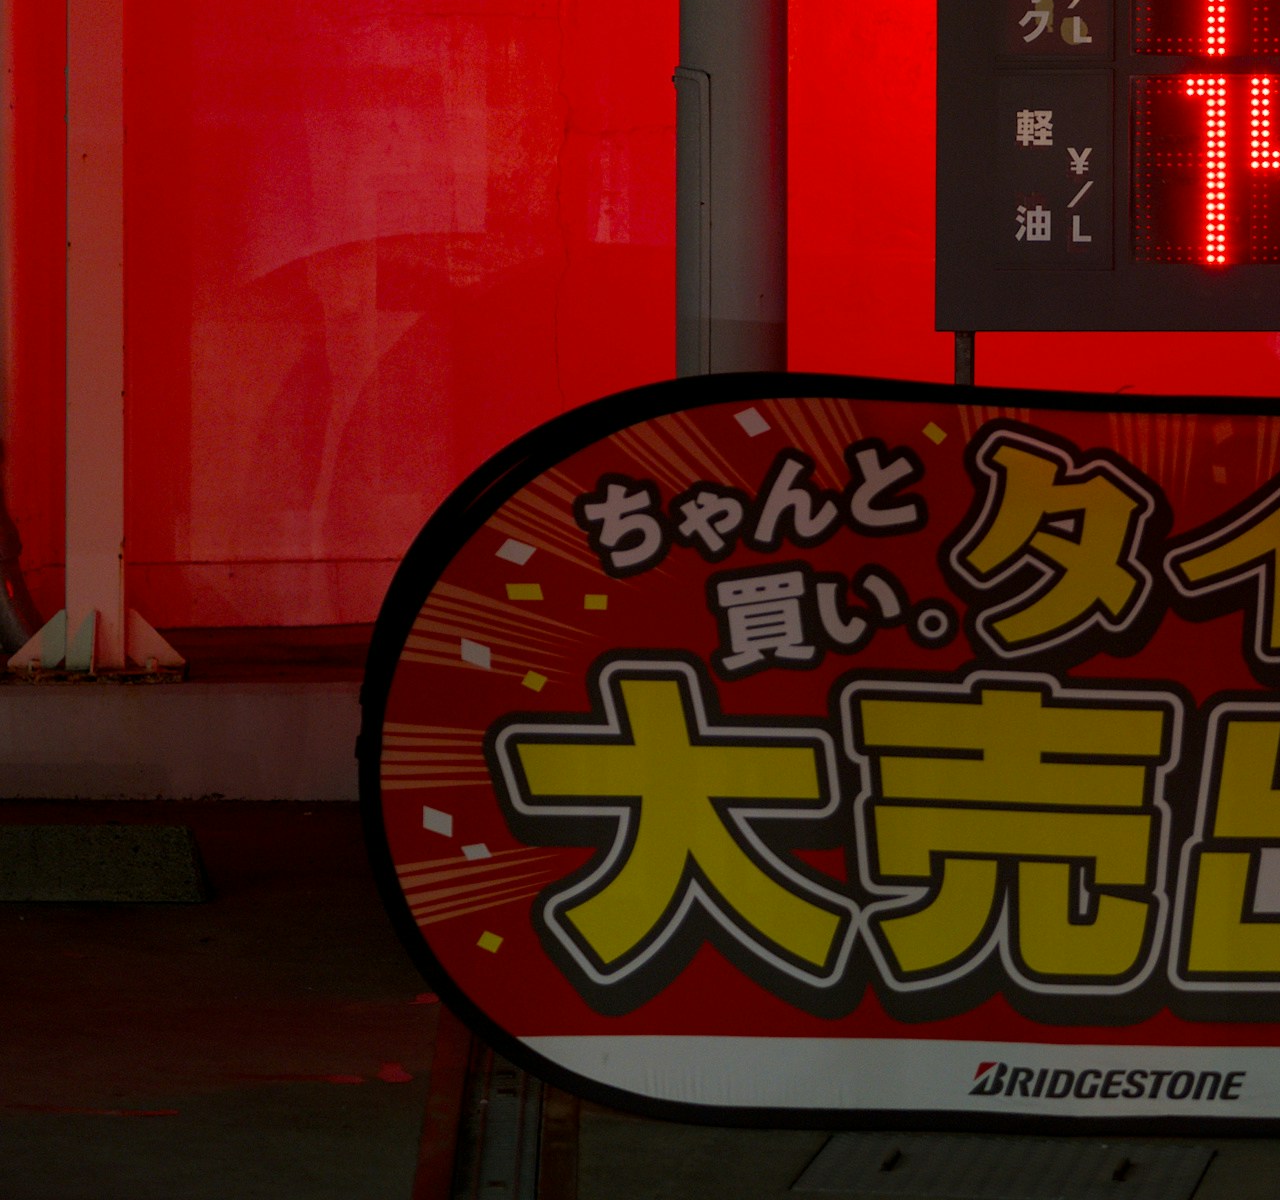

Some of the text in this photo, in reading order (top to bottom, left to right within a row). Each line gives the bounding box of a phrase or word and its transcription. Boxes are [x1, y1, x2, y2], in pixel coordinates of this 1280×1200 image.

[1014, 108, 1054, 242] 軽油
[582, 447, 919, 569] ちゃんと
[715, 570, 949, 672] 買い。
[967, 1061, 1247, 1101] BRIDGESTONE
